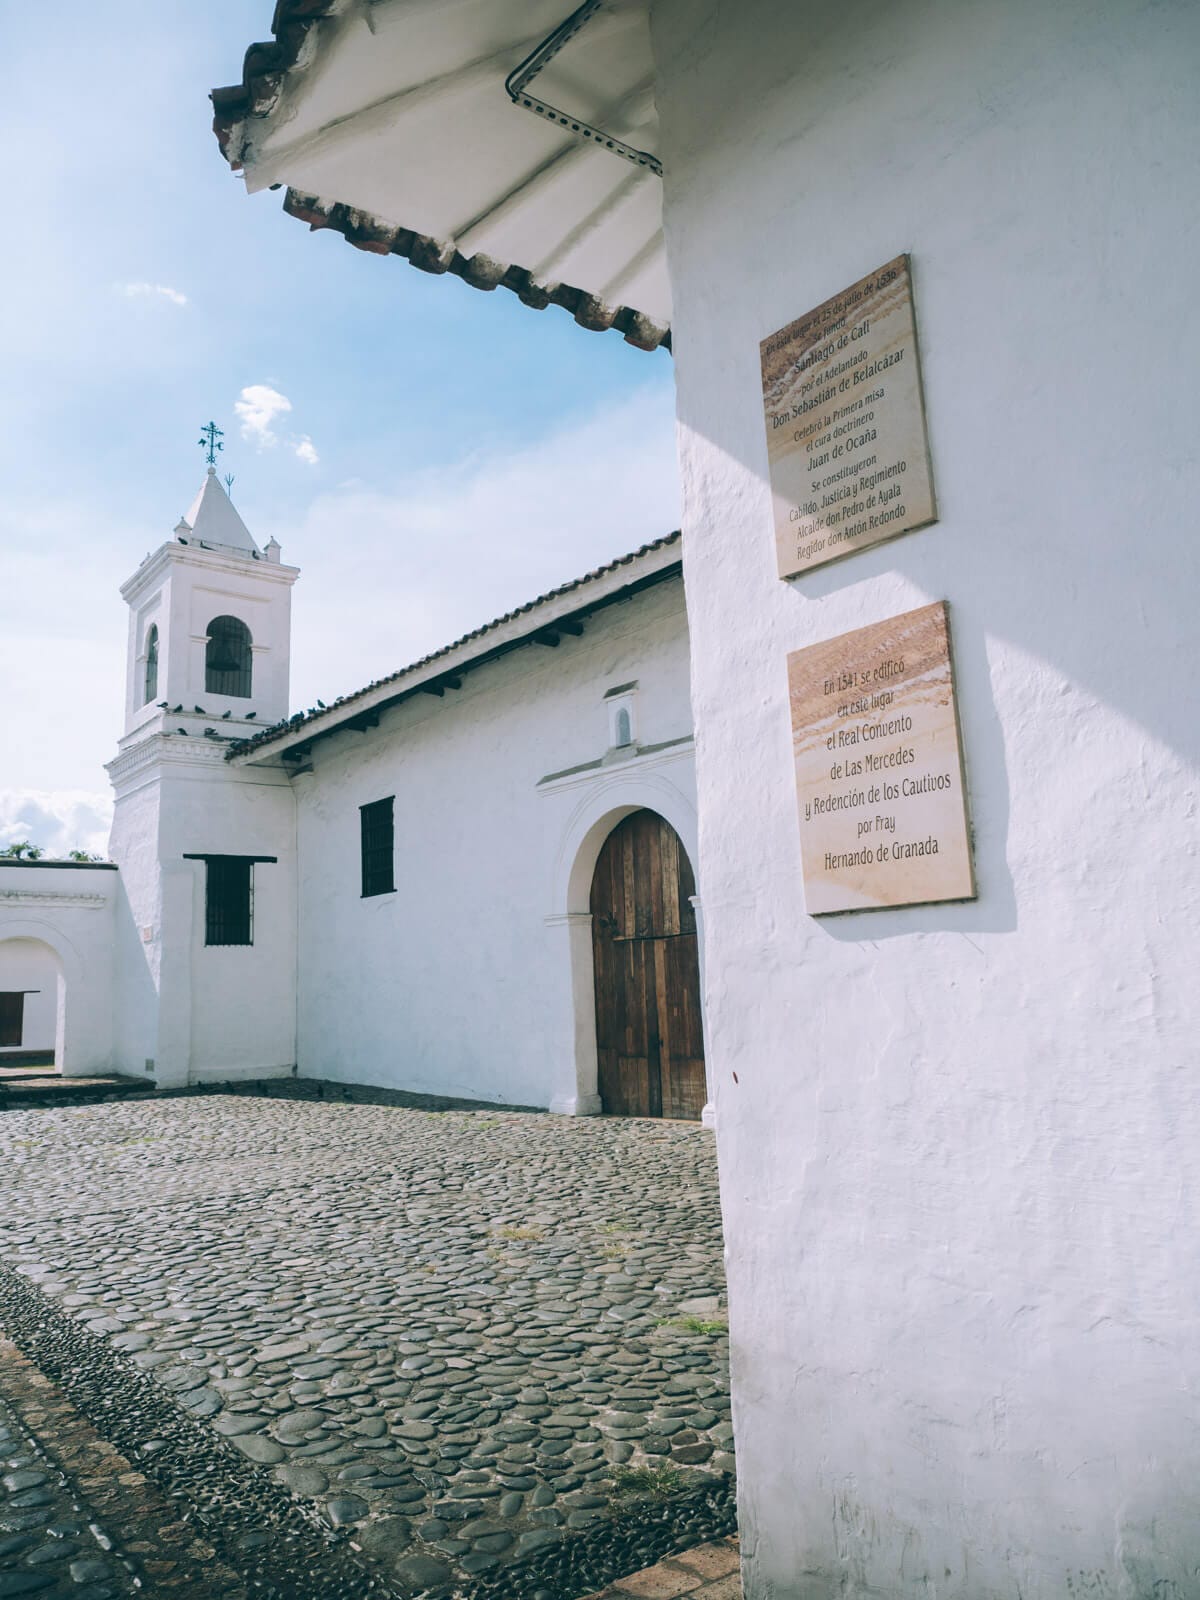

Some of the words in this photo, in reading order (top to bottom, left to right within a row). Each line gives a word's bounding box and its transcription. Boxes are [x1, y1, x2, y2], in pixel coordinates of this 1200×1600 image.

[814, 314, 820, 327] el
[832, 302, 842, 314] de
[844, 290, 862, 311] julio
[864, 283, 874, 296] de
[794, 344, 834, 374] Santiago
[838, 336, 848, 350] de
[851, 320, 870, 340] Cali
[773, 412, 790, 429] Don
[792, 384, 836, 418] Sebastián
[838, 378, 850, 392] de
[853, 349, 904, 386] Belalcázar
[801, 383, 814, 397] por
[816, 376, 824, 386] el
[824, 350, 868, 381] Adelantado
[794, 420, 822, 442] Celebró
[824, 415, 830, 426] la
[833, 398, 863, 422] Primera
[865, 386, 884, 406] misa
[806, 440, 814, 452] el
[814, 433, 831, 448] cura
[833, 411, 874, 438] doctrinero
[808, 452, 830, 472] Juan
[832, 444, 844, 459] de
[846, 428, 877, 452] Ocaña
[790, 501, 819, 522] Cabildo,
[820, 486, 850, 509] Justicia
[852, 483, 858, 498] y
[860, 461, 906, 492] Regimiento
[812, 480, 820, 492] Se
[822, 455, 876, 488] constituyeron
[797, 517, 824, 540] Alcalde
[826, 512, 840, 526] don
[842, 500, 864, 520] Pedro
[866, 494, 876, 509] de
[878, 484, 901, 505] Ayala
[797, 538, 826, 560] Regidor
[828, 532, 842, 546] don
[844, 520, 867, 540] Antón
[869, 504, 906, 530] Redondo
[824, 680, 834, 696] En
[838, 672, 858, 691] 1541
[861, 670, 870, 684] se
[874, 656, 904, 681] edificó
[838, 704, 848, 718] en
[850, 698, 868, 714] este
[872, 691, 894, 710] lugar
[827, 732, 836, 750] el
[838, 726, 860, 748] Real
[862, 714, 912, 742] Convento
[830, 762, 842, 780] de
[845, 760, 862, 777] Las
[865, 746, 914, 772] Mercedes
[805, 802, 810, 821] y
[814, 788, 865, 815] Redención
[868, 785, 880, 804] de
[883, 782, 900, 800] los
[902, 772, 952, 796] Cautivos
[858, 820, 872, 838] por
[876, 816, 896, 834] Fray
[824, 846, 873, 870] Hernando
[876, 843, 888, 862] de
[892, 835, 939, 860] Granada
